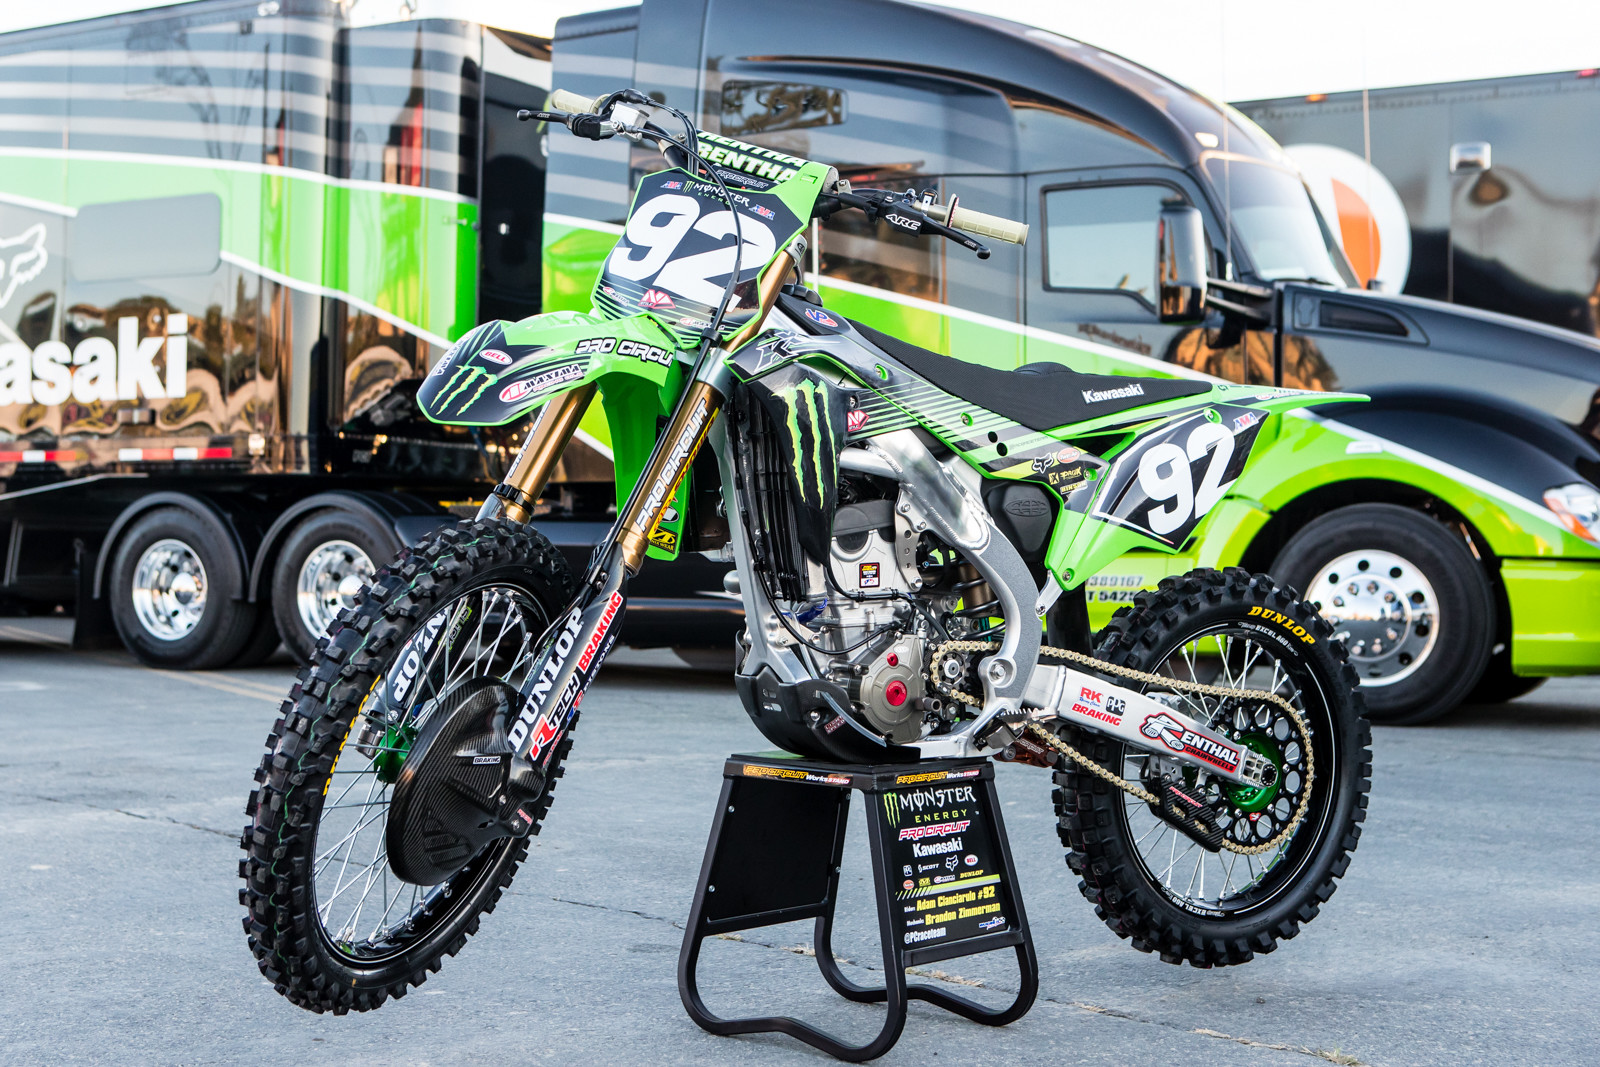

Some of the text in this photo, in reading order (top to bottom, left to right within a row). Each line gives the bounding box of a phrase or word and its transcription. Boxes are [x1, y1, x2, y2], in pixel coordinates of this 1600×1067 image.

[697, 141, 798, 182] RENTHA
[697, 192, 738, 207] ENERG
[885, 213, 922, 231] ARC
[609, 194, 776, 313] 92
[483, 350, 507, 363] BELL
[617, 339, 674, 368] CIRCU
[523, 364, 581, 391] MAXIMA
[1081, 383, 1145, 405] Kawasaki
[1234, 411, 1259, 431] AMA
[1138, 422, 1238, 535] 92
[575, 590, 624, 675] BRAKING
[1247, 605, 1316, 645] DUNLOP
[1255, 624, 1277, 640] EXCEL
[507, 606, 583, 753] DUNLOP
[1080, 686, 1104, 704] RK
[1071, 703, 1122, 727] BRAKING
[473, 756, 501, 765] BRAKING
[1184, 746, 1236, 773] CHAINWHEELS
[899, 786, 977, 813] MONSTER
[914, 808, 968, 824] ENERGY
[912, 836, 964, 858] Kawasaki
[959, 869, 984, 879] DUNLOP
[916, 898, 936, 912] Adam
[937, 890, 976, 908] Cianciarulo
[977, 885, 995, 900] #92
[925, 910, 957, 926] Brandon
[958, 902, 1001, 919] Zimmerman
[904, 926, 947, 945] @PCraceteam
